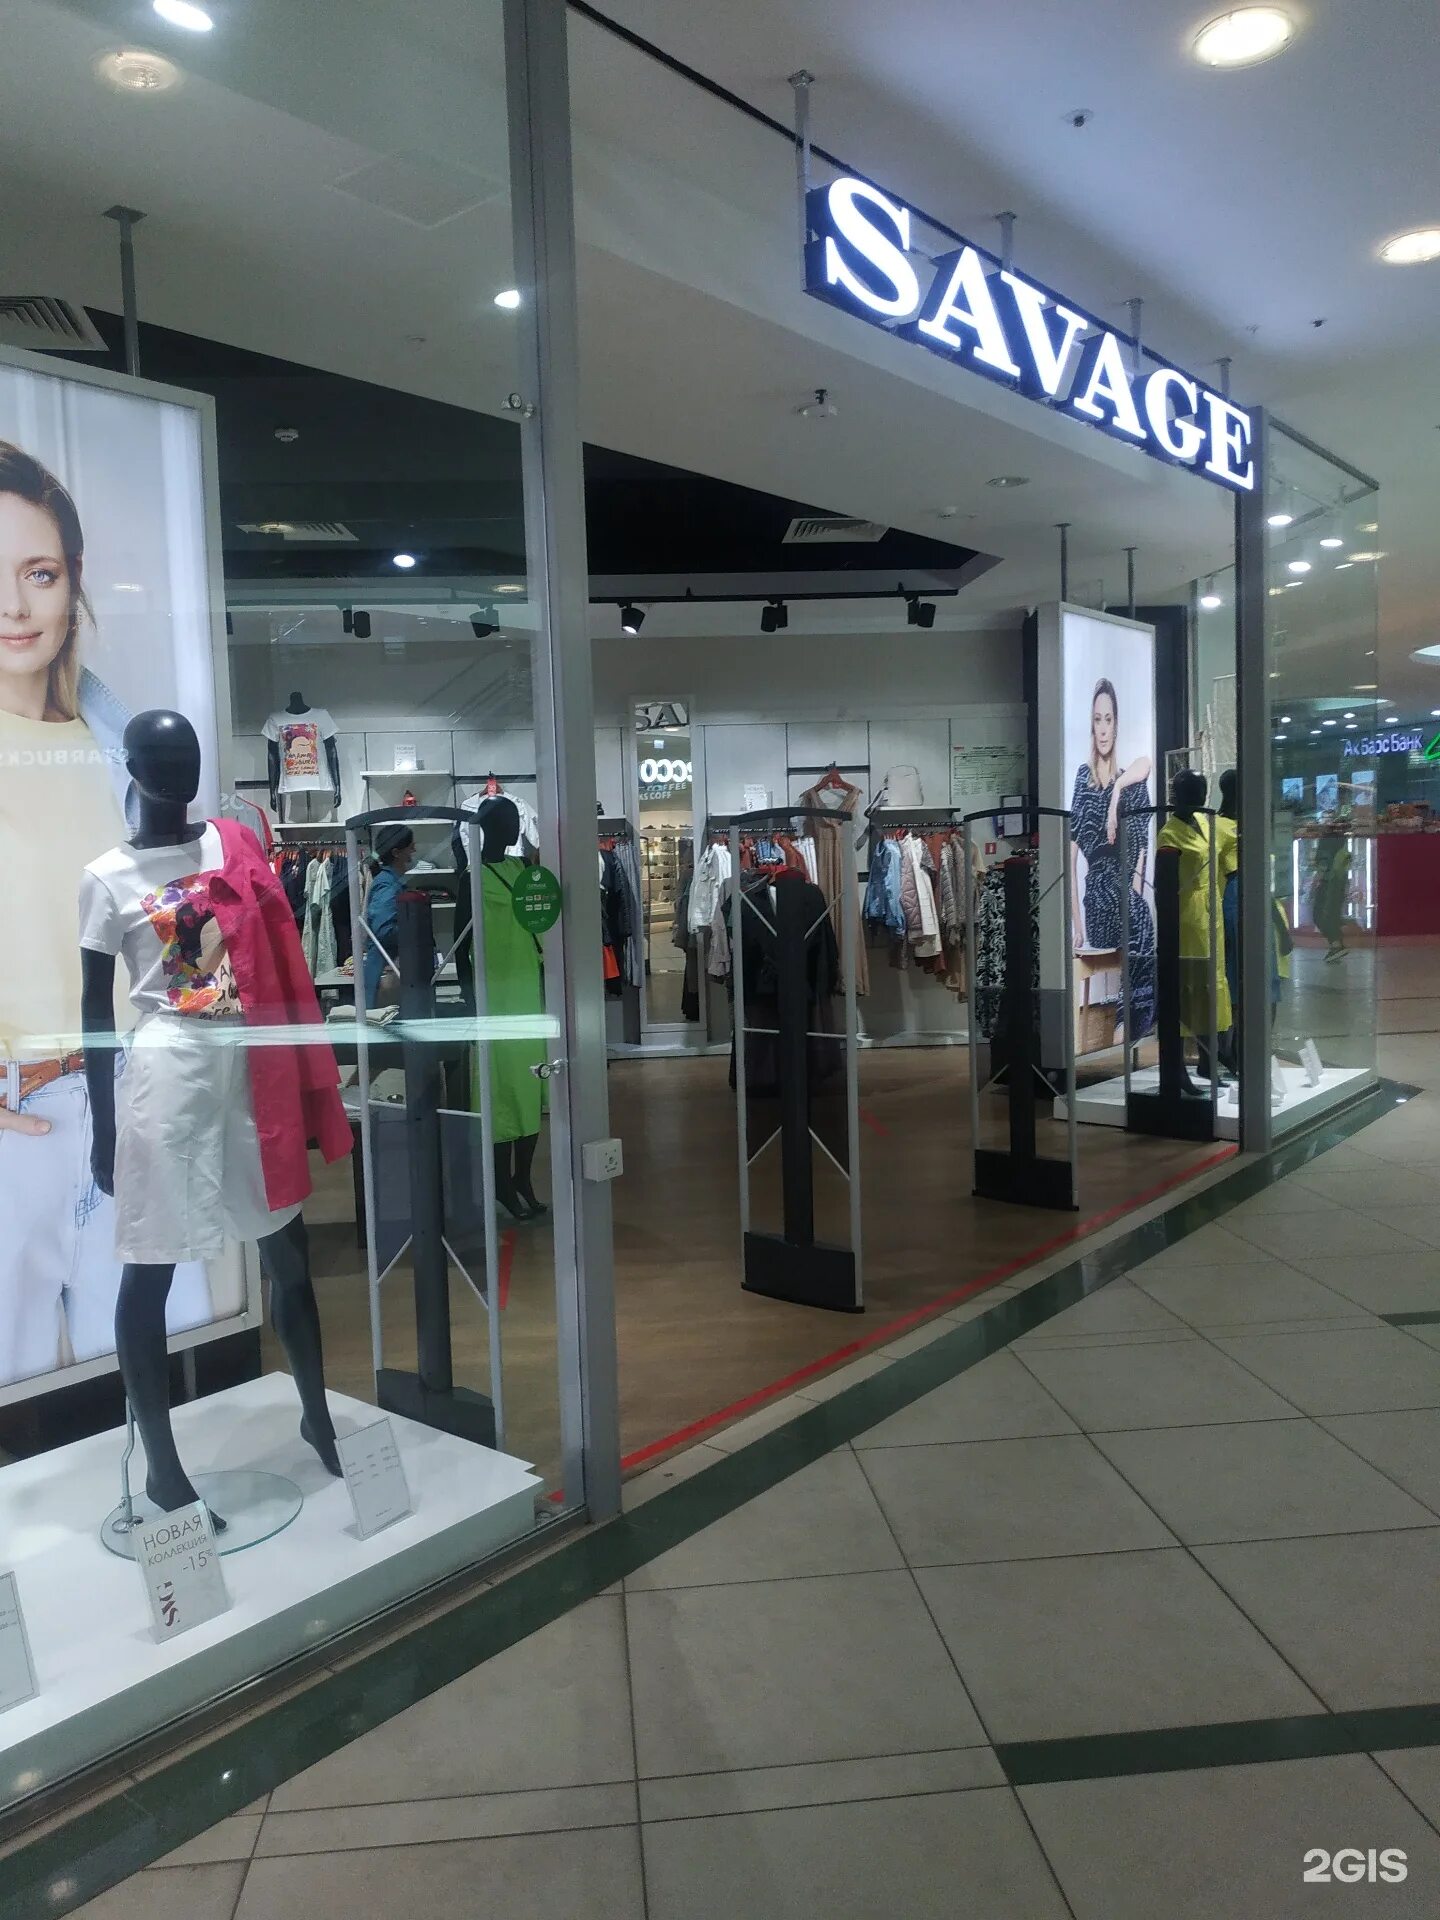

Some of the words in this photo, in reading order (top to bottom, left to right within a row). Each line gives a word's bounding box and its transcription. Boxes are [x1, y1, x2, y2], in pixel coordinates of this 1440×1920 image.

[826, 177, 1255, 491] SAVAGE
[1391, 733, 1423, 752] Банк
[142, 1514, 204, 1552] НОВАЯ
[147, 1534, 208, 1567] КОЛЛЕКЦИЯ
